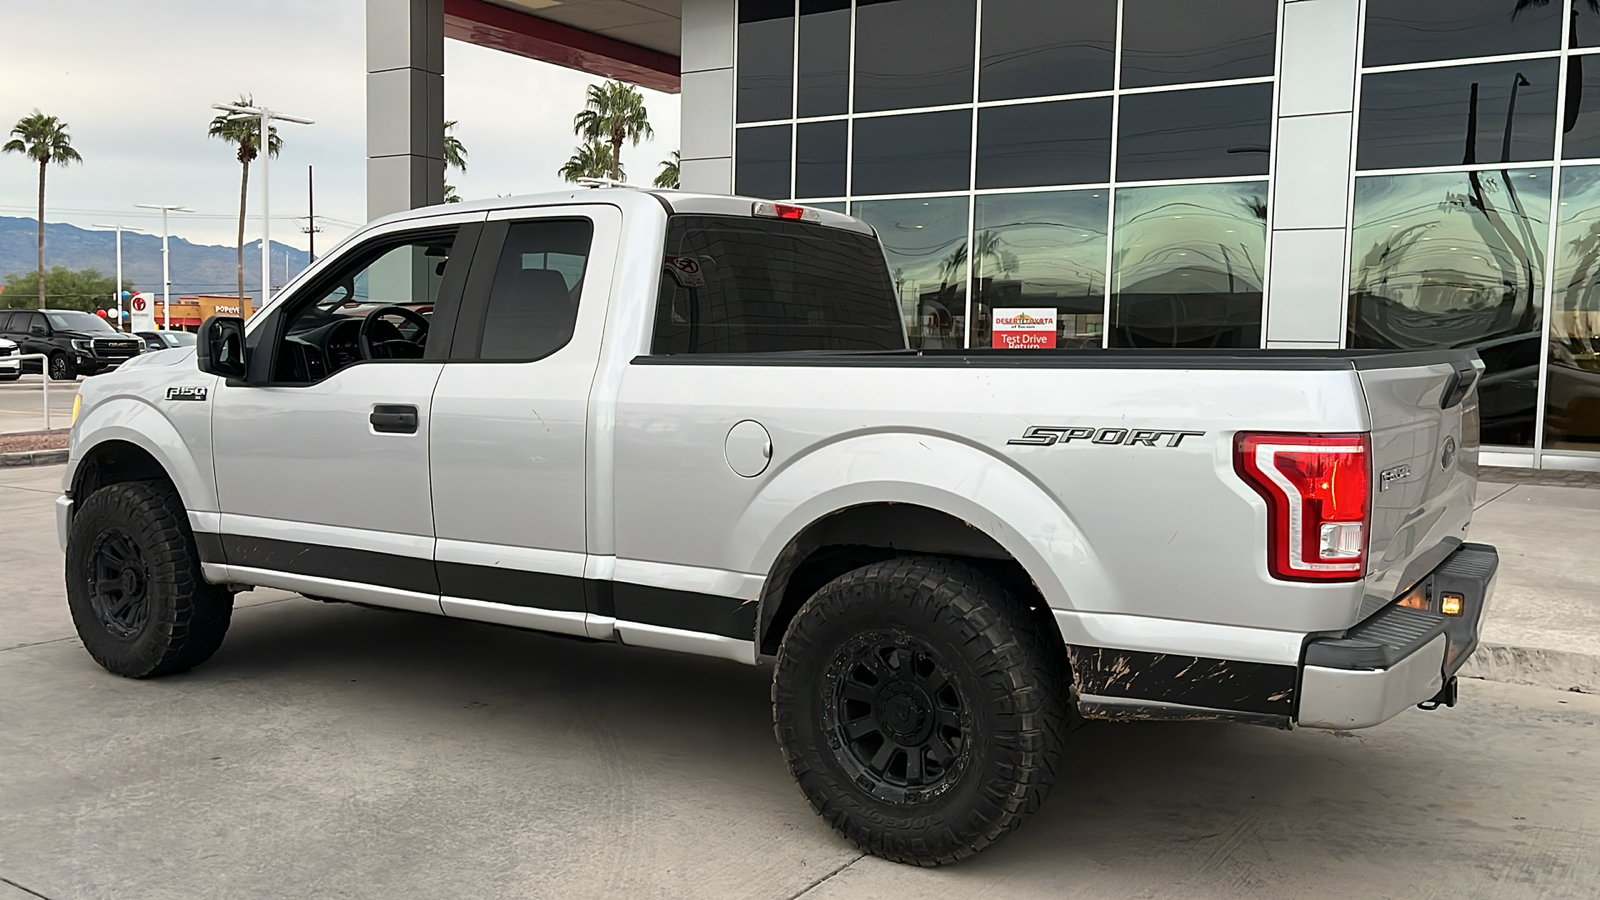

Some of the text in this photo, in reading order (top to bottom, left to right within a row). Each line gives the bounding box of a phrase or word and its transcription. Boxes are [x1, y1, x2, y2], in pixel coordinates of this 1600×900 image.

[214, 305, 240, 314] POPEYE
[1001, 334, 1047, 343] Test Drive
[1006, 425, 1206, 448] SPORT
